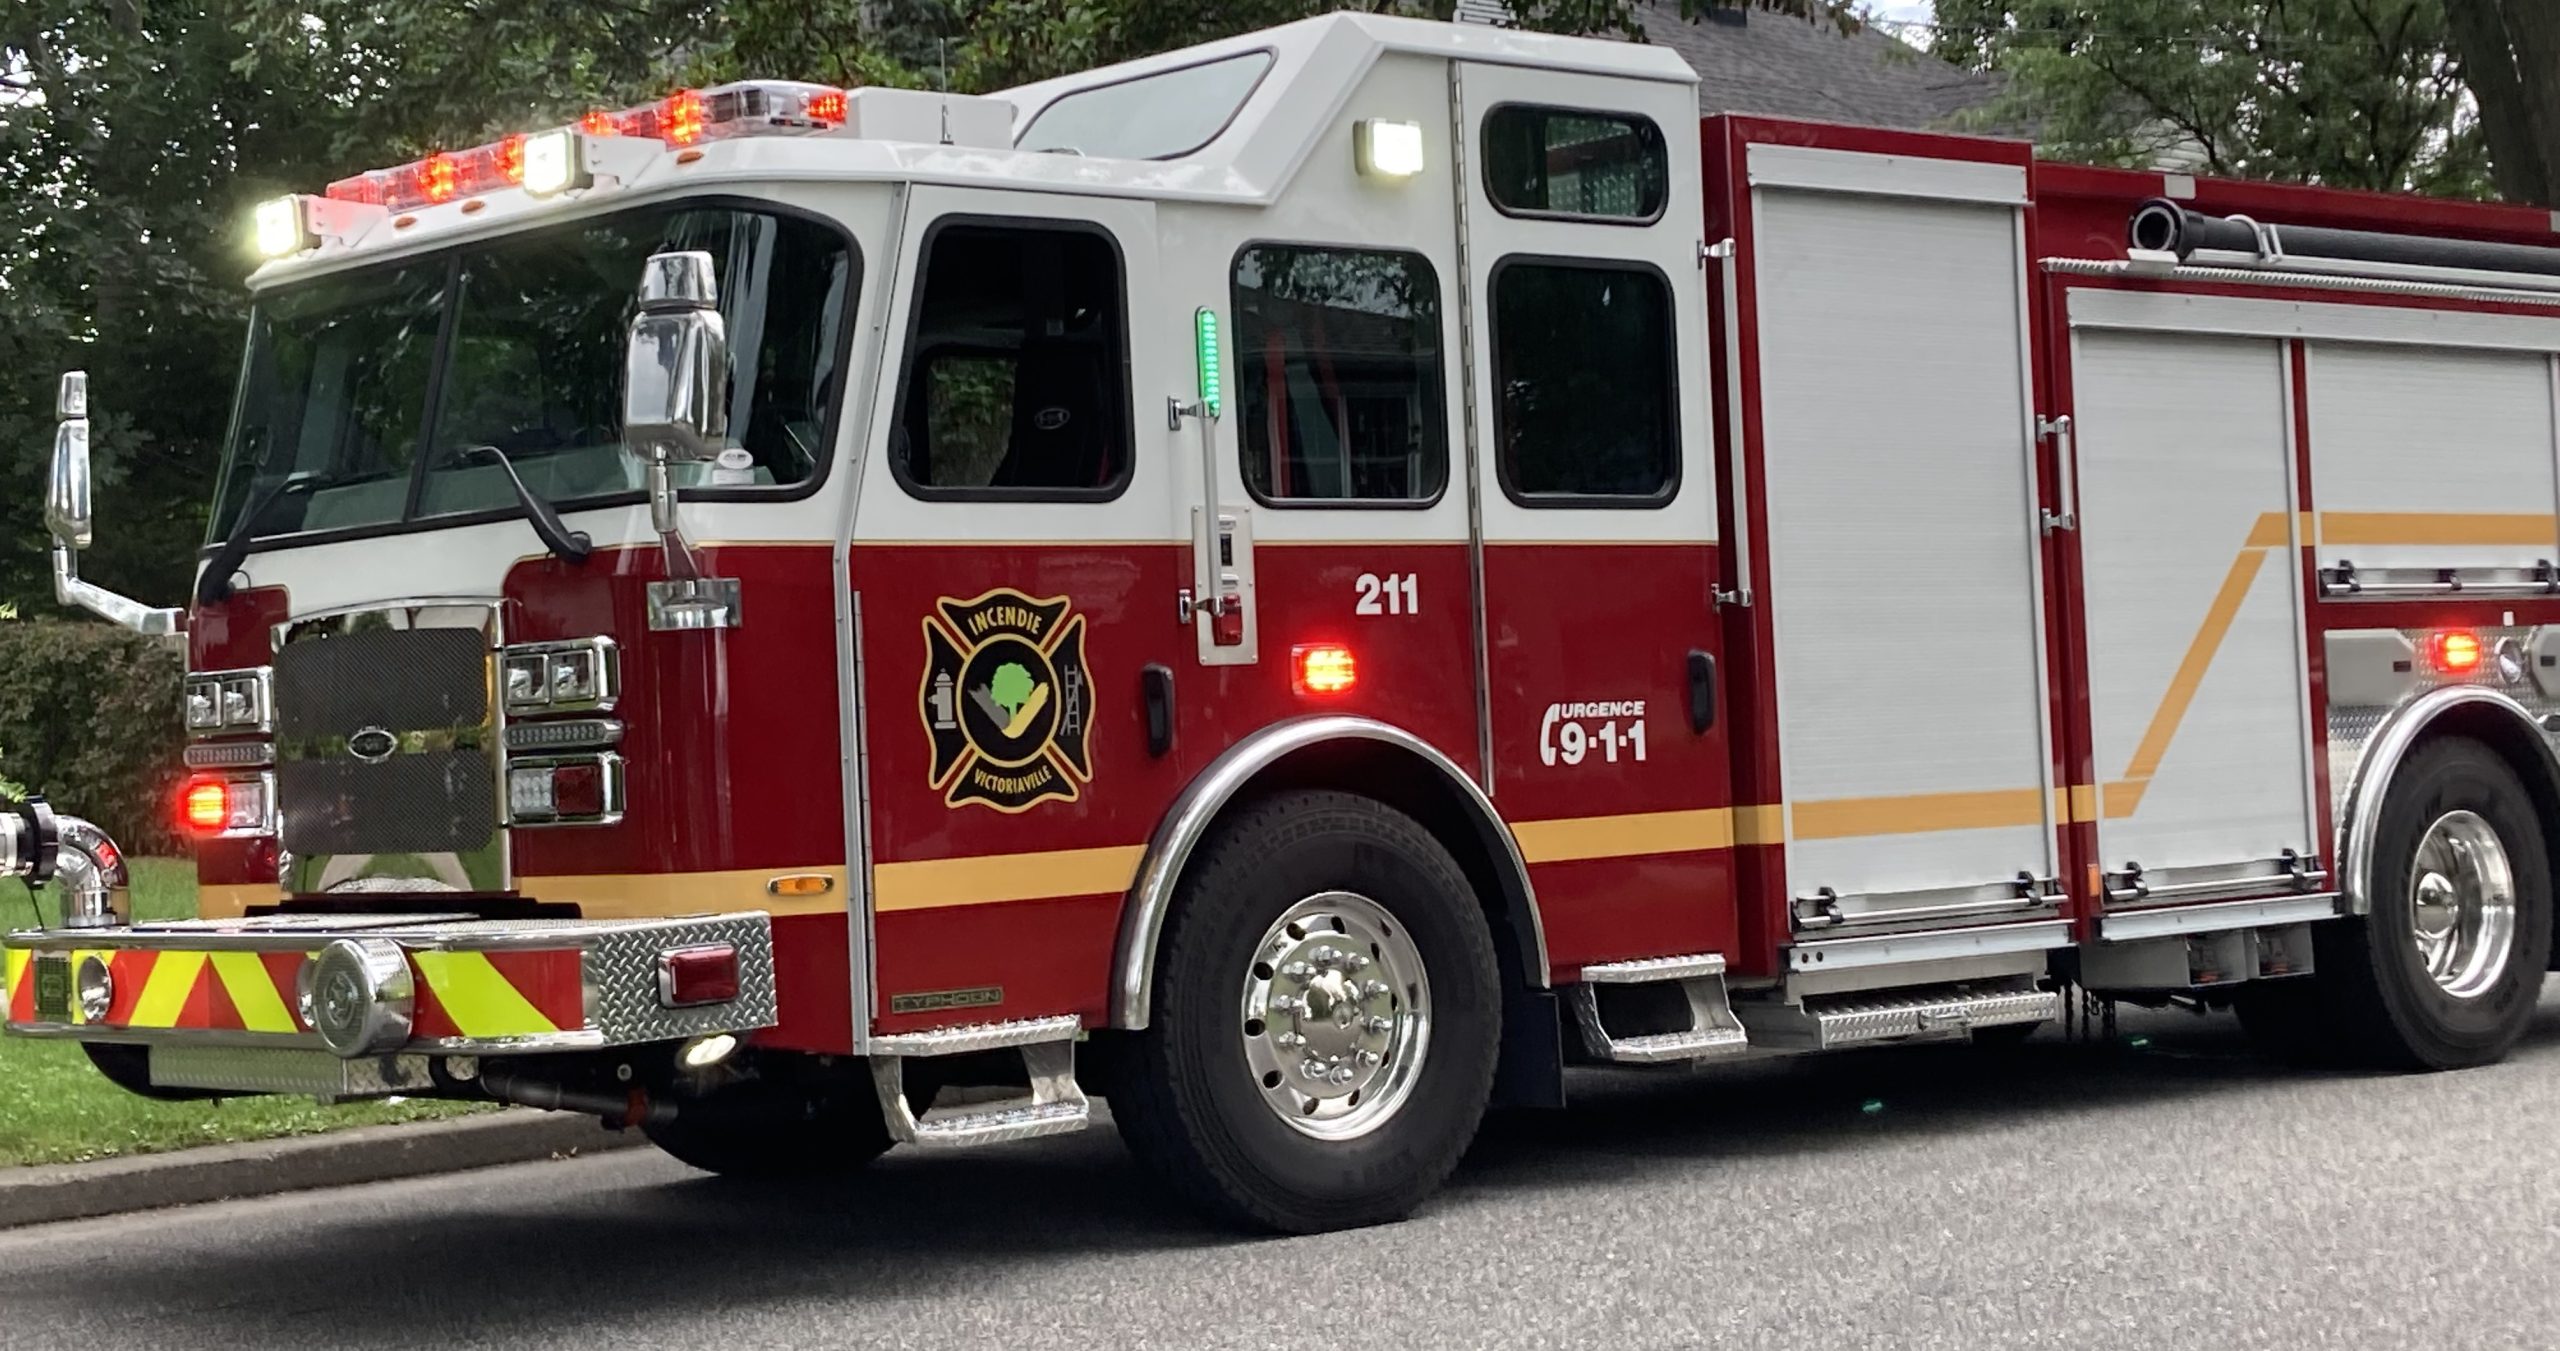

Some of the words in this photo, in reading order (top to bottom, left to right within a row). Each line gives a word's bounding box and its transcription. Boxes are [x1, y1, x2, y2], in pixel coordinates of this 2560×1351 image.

[1355, 573, 1418, 614] 211
[968, 606, 1042, 635] INCENDIE
[1561, 701, 1646, 718] URGENCE
[974, 765, 1052, 793] VICTORIAVILLE
[894, 990, 1000, 1010] TYPHOON
